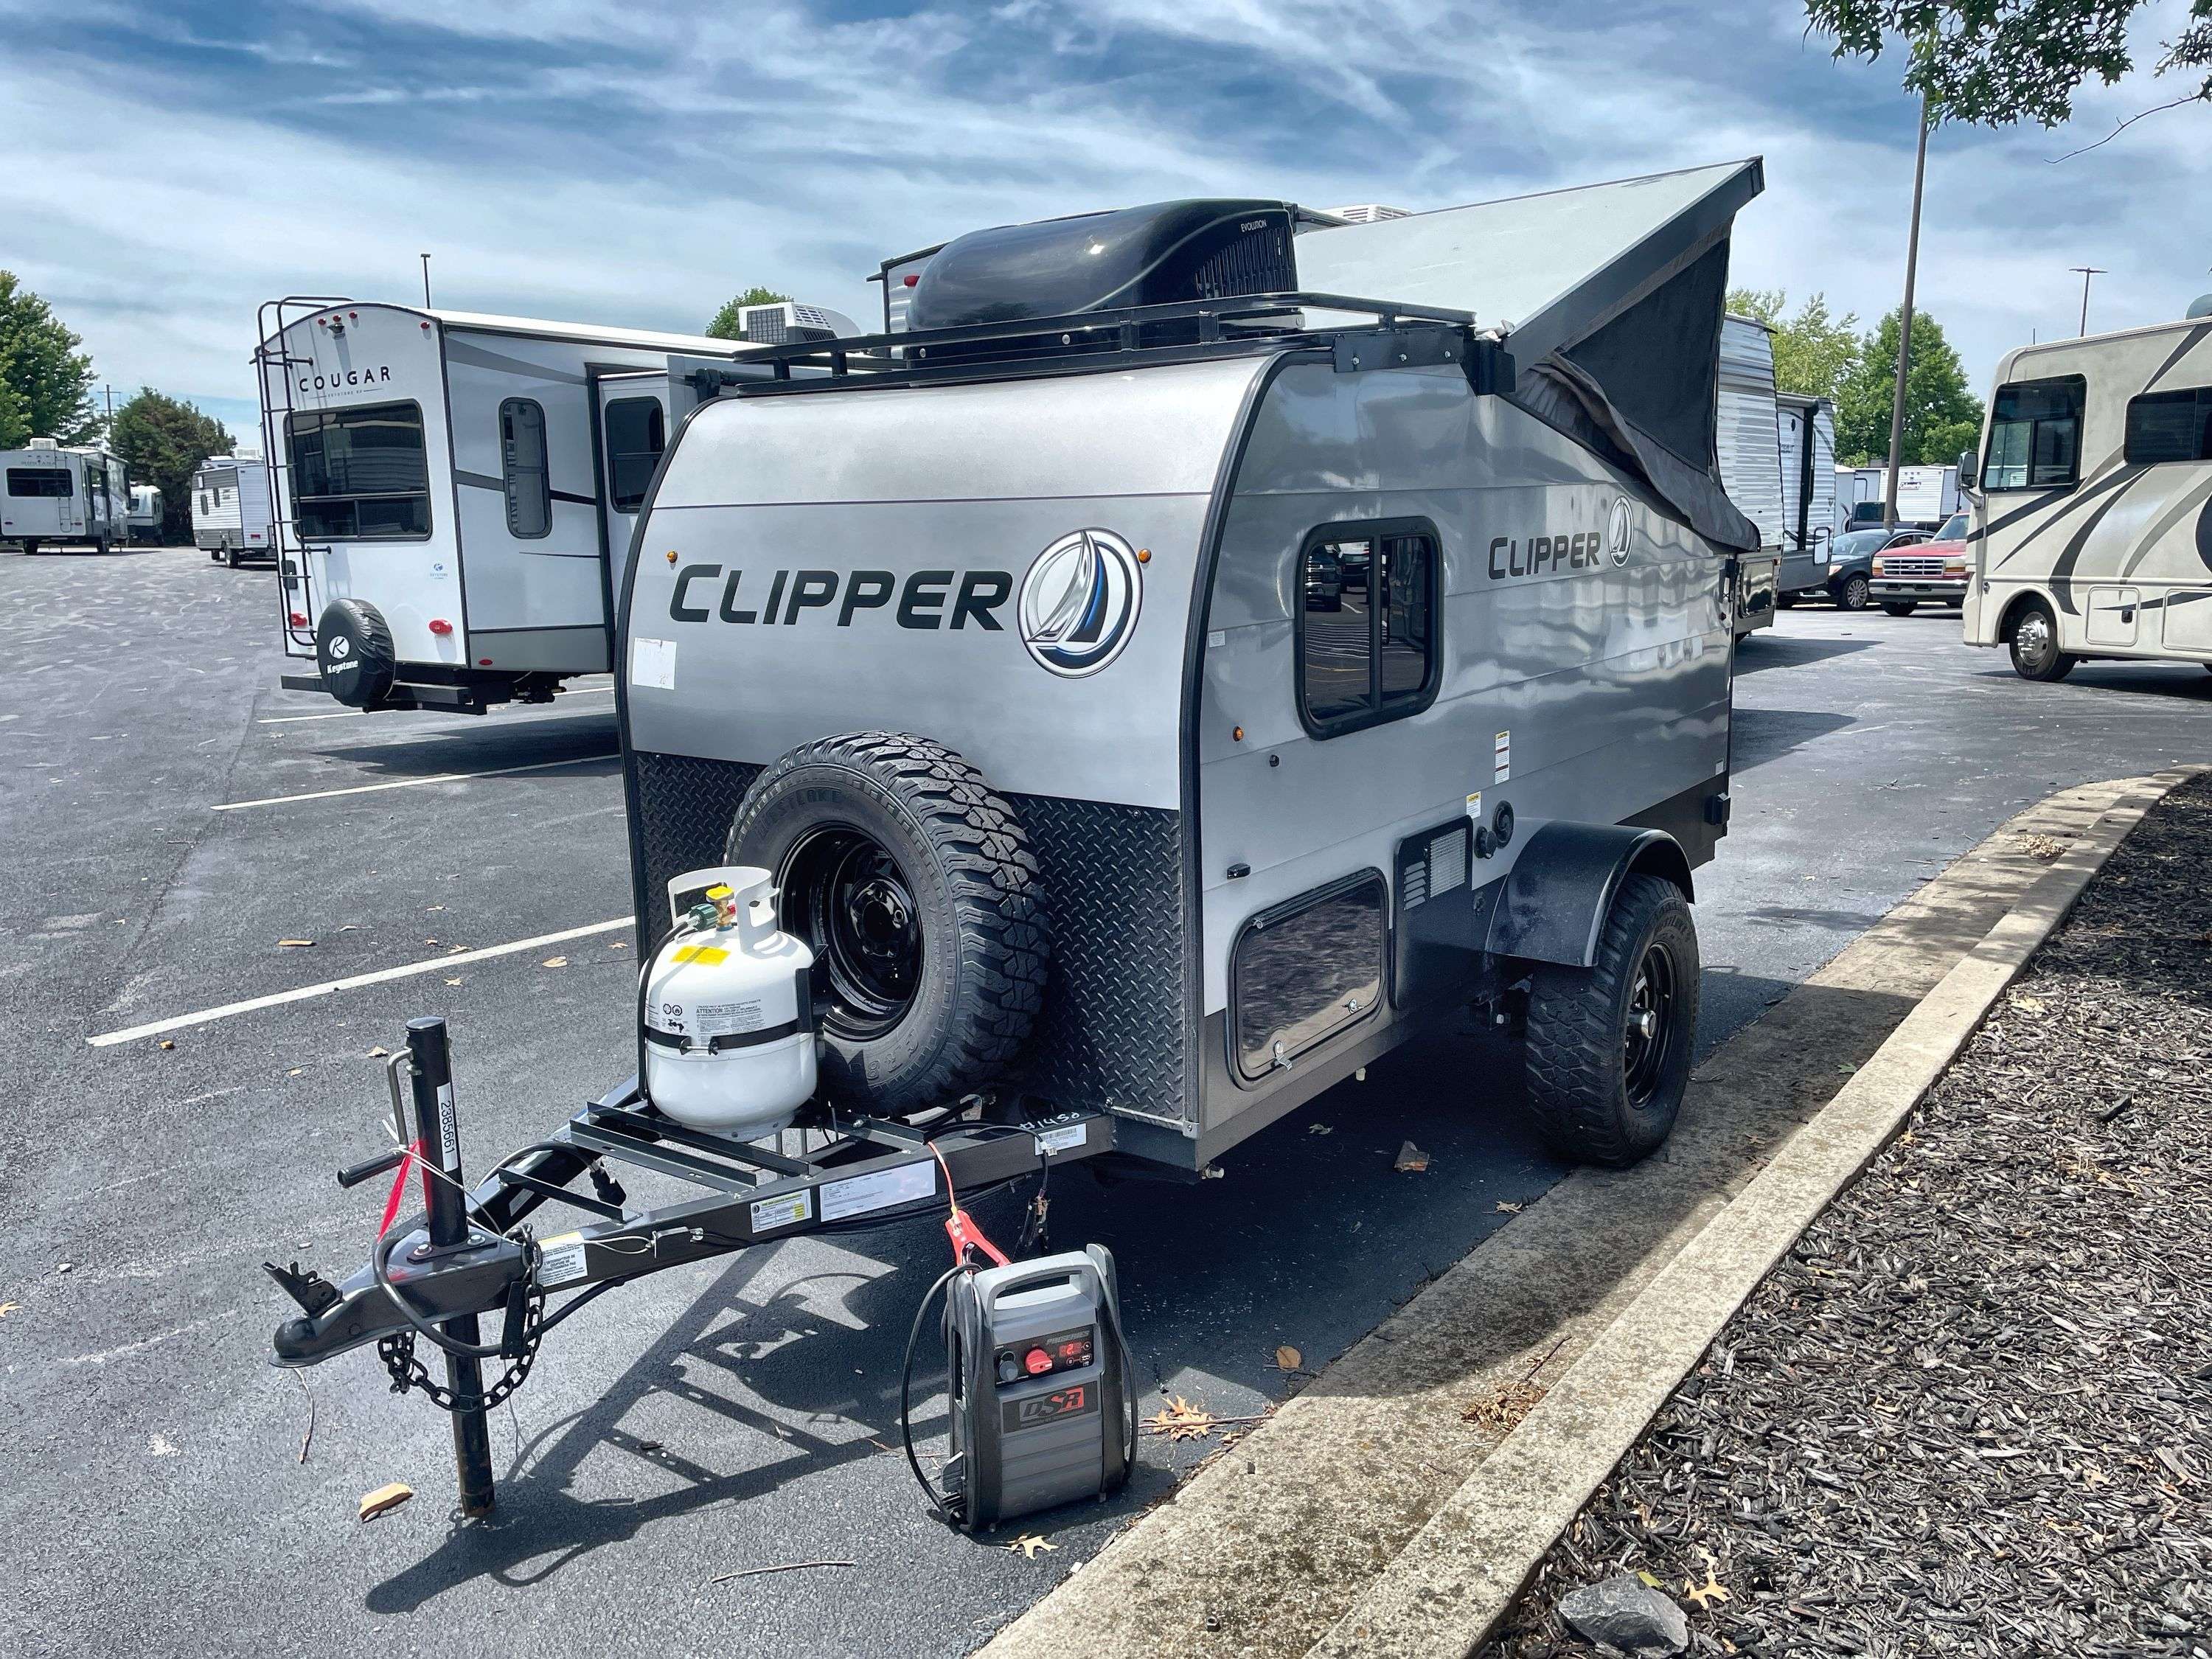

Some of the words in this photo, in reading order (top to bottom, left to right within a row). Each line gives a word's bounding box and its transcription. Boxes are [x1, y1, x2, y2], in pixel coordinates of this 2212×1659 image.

[1240, 219, 1268, 232] EVOLUTION
[299, 366, 391, 392] COUGAR
[1488, 532, 1601, 580] CLIPPER
[669, 564, 1013, 631] CLIPPER
[327, 660, 358, 674] Keystone
[441, 1100, 456, 1154] 2385661
[1023, 1391, 1082, 1417] DSR
